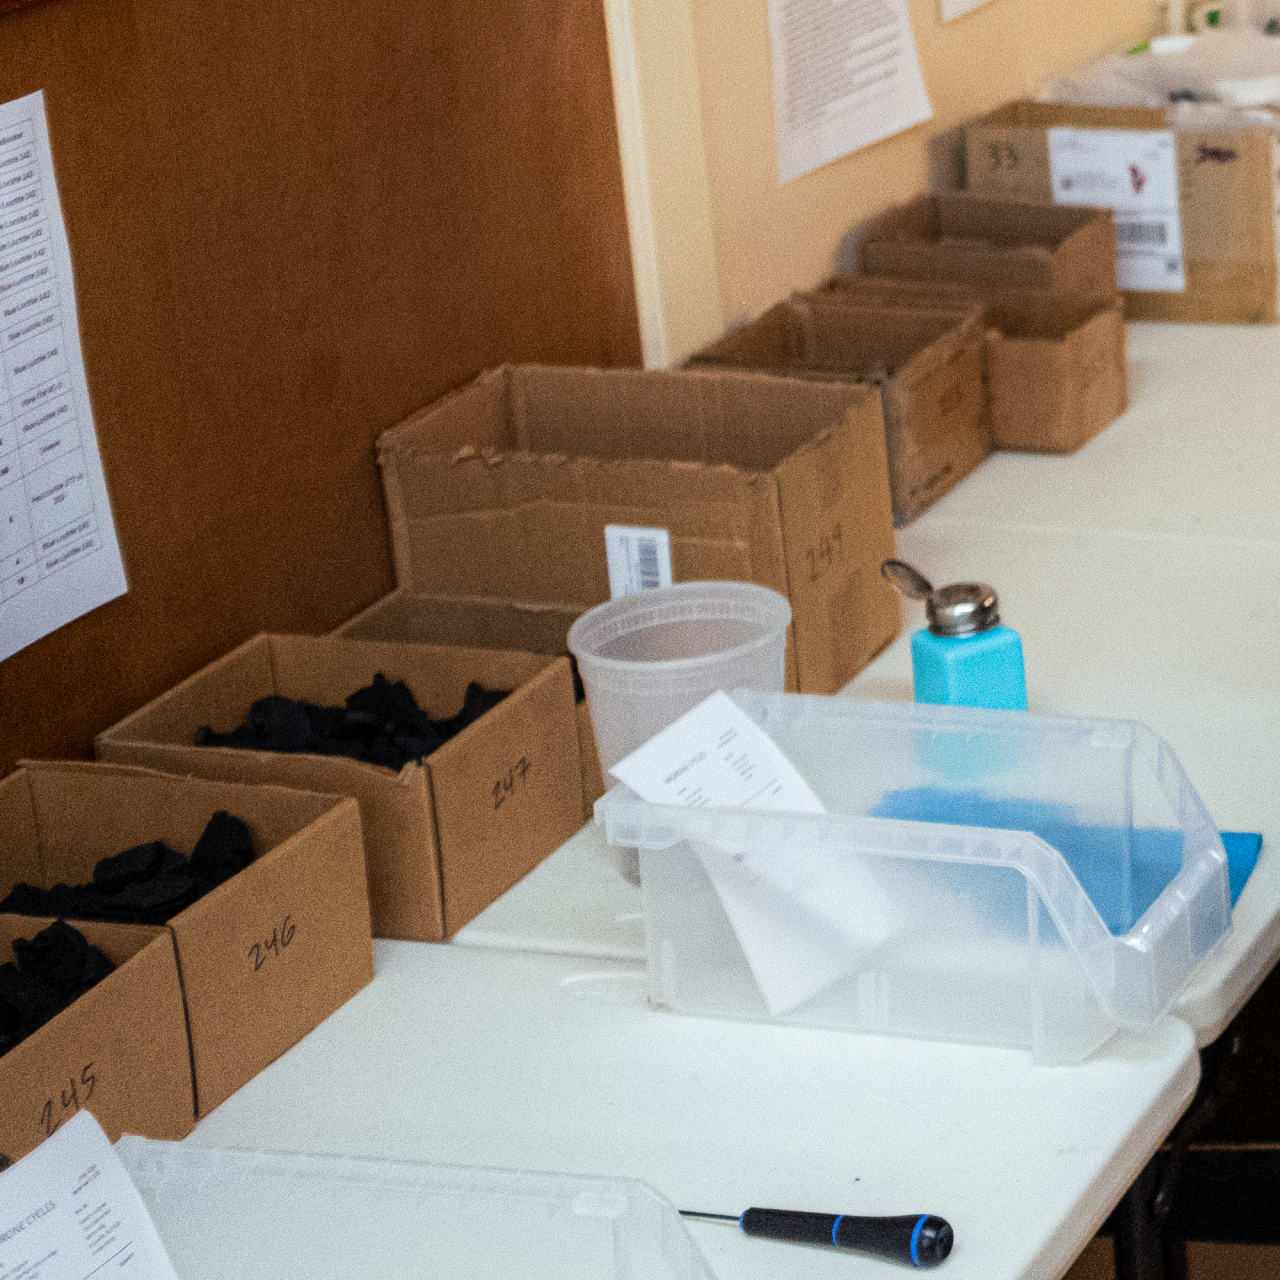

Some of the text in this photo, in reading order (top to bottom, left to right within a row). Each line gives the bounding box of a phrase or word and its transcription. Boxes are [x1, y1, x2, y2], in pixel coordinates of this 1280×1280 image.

[490, 755, 531, 810] 247
[248, 915, 297, 972] 246
[40, 1062, 97, 1137] 245
